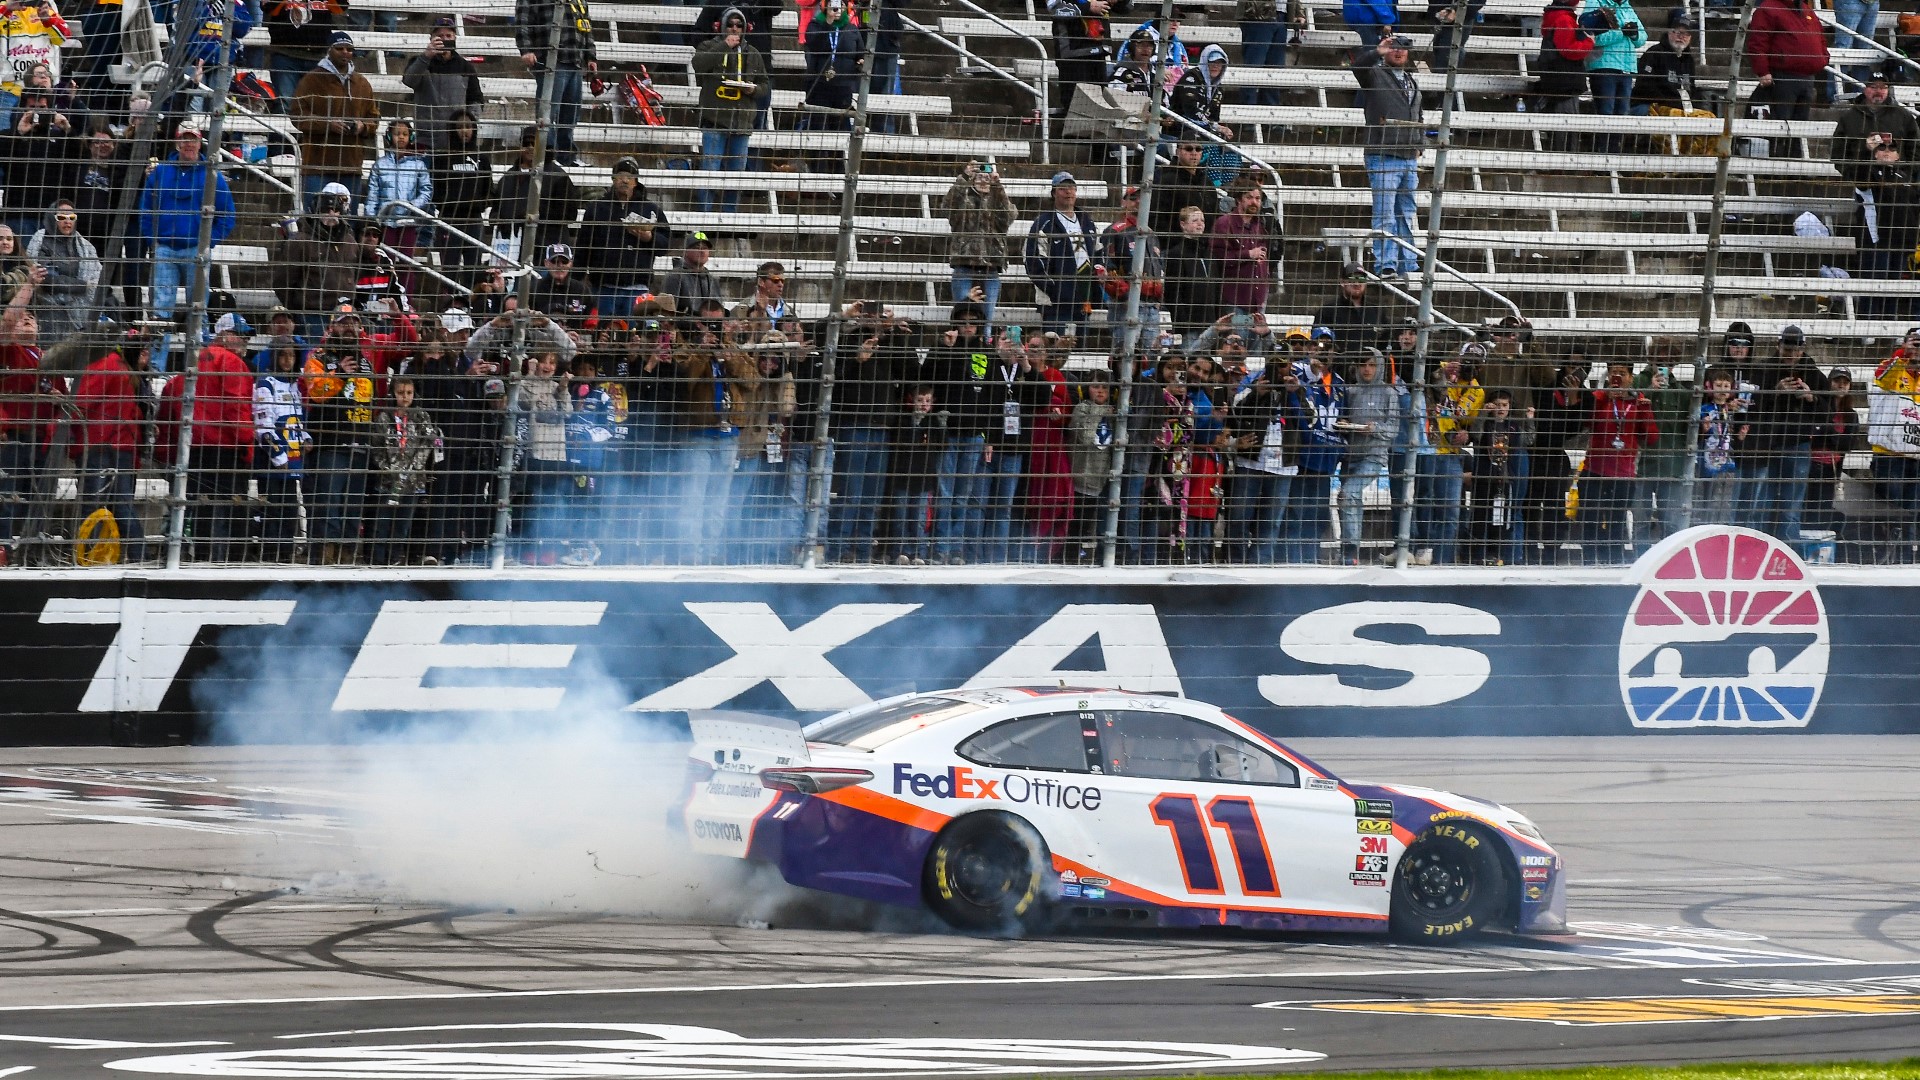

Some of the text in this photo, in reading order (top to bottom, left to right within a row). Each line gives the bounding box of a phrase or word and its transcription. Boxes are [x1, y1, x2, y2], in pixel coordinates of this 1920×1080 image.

[37, 597, 1502, 712] TEXAS
[893, 762, 1102, 811] FedEx Office
[704, 820, 743, 842] TOYOTA
[1148, 791, 1282, 898] 11
[1360, 836, 1388, 854] 3M
[1350, 872, 1381, 881] LINCOLN
[1424, 915, 1474, 936] EAGLE
